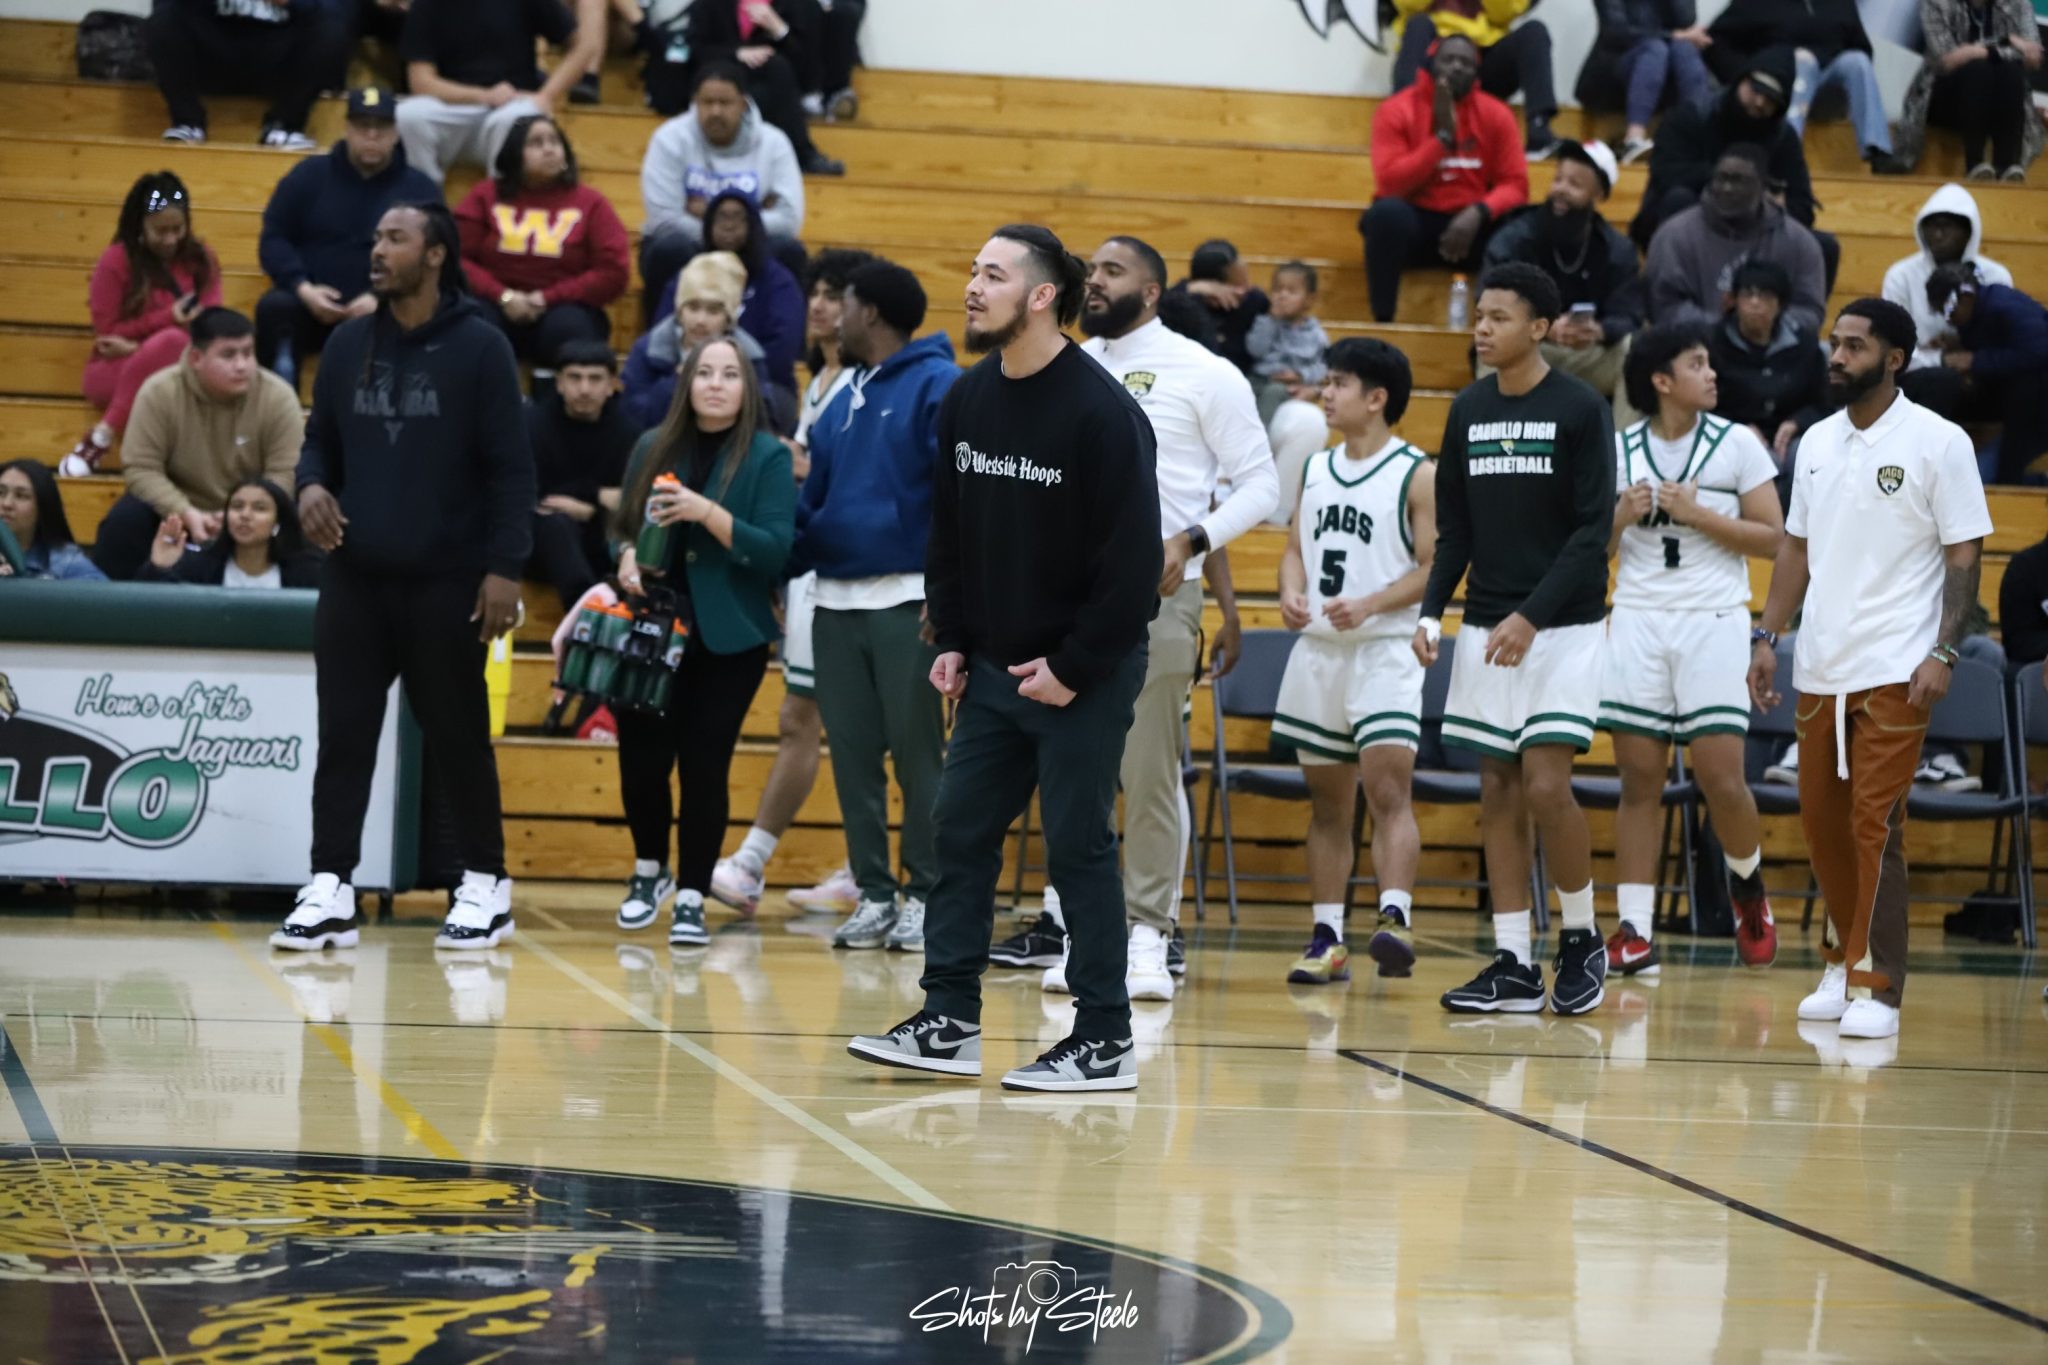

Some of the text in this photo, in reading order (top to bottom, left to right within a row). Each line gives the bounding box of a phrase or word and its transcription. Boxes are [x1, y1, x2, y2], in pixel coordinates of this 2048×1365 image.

[491, 202, 583, 258] W
[1468, 421, 1557, 442] CABRILLO HIGH
[971, 450, 1062, 487] Westside Hoops
[1469, 456, 1554, 476] BASKETBALL
[1879, 467, 1903, 480] JAGS
[1313, 504, 1374, 545] JAGS
[1661, 536, 1681, 568] 1
[1318, 549, 1347, 597] 5
[75, 673, 251, 720] Home of the
[161, 712, 301, 780] Jaguars
